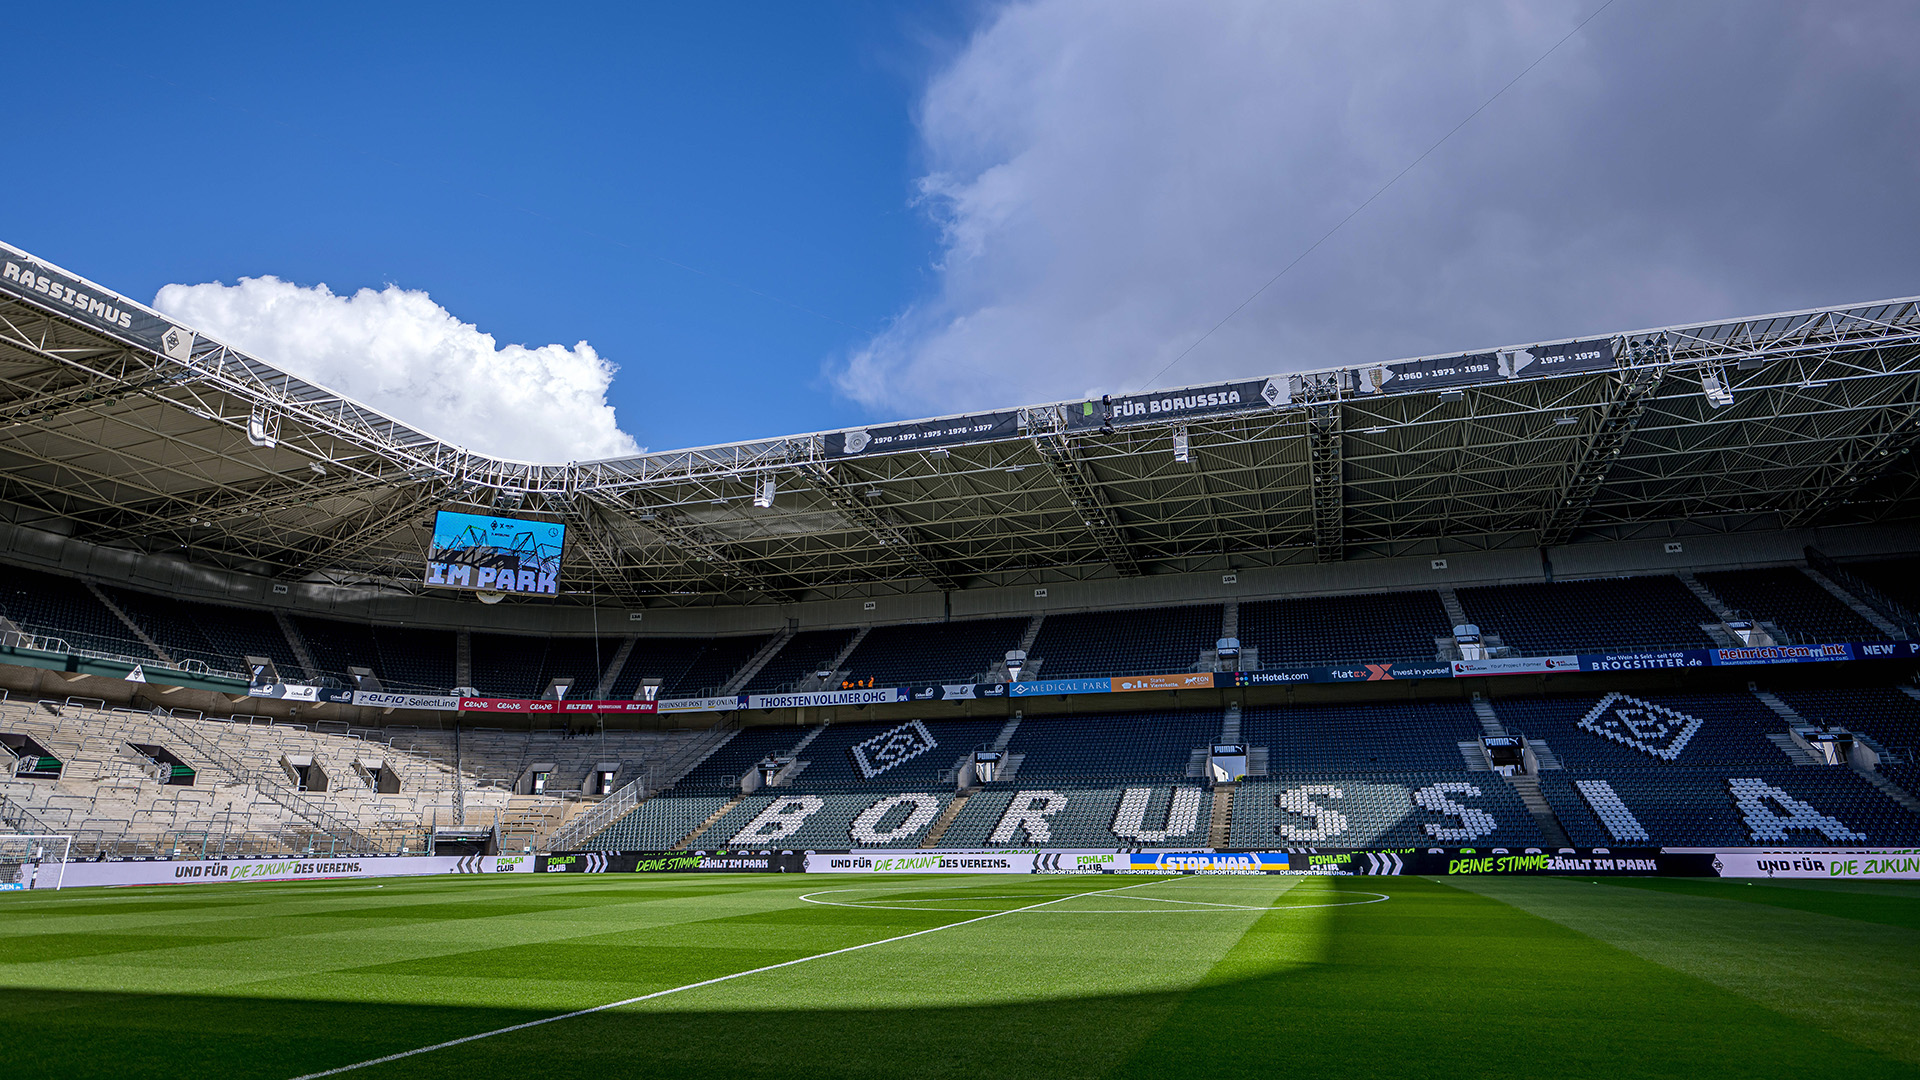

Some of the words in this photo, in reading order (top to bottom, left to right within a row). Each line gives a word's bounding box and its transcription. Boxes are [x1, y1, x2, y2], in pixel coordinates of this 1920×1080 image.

[3, 261, 132, 328] RASSISMUS
[1540, 355, 1564, 364] 1975
[1575, 351, 1600, 360] 1979
[1398, 372, 1422, 381] 1960
[1432, 368, 1455, 377] 1973
[1464, 364, 1490, 373] 1995
[1113, 401, 1146, 418] FÜR
[1150, 390, 1240, 413] BORUSSIA
[874, 436, 892, 444] 1970
[899, 433, 916, 442] 1971
[924, 430, 942, 438] 1975
[948, 427, 967, 435] 1976
[974, 424, 992, 432] 1977
[428, 562, 471, 586] IM
[476, 566, 558, 594] PARK
[1720, 648, 1777, 660] Heinrich
[1778, 644, 1847, 658] Temmink
[1392, 668, 1411, 676] Invest
[1592, 658, 1702, 670] BROGSITTER.de
[1252, 672, 1308, 682] H-Hotels.com
[1030, 683, 1078, 692] MEDICAL
[1083, 681, 1109, 690] PARK
[408, 698, 456, 708] SelectLine
[760, 696, 812, 708] THORSTEN
[813, 694, 861, 706] VOLLMER
[863, 692, 886, 702] OHG
[728, 777, 1868, 846] BORUSSIA
[496, 856, 524, 865] FOHLEN
[548, 856, 576, 865] FOHLEN
[636, 858, 667, 872] DEINE
[667, 856, 702, 870] STIMME
[699, 856, 728, 868] ZÄHLT
[728, 860, 742, 868] IM
[743, 859, 768, 868] PARK
[830, 859, 851, 868] UND
[852, 856, 872, 868] FÜR
[874, 858, 893, 872] DIE
[894, 856, 942, 870] ZUKUNFT
[939, 859, 960, 868] DES
[960, 859, 1010, 868] VEREINS.
[1076, 854, 1114, 864] FOHLEN
[1166, 856, 1210, 870] STOP
[1213, 856, 1250, 870] WAR
[1308, 854, 1352, 865] FOHLEN
[1448, 857, 1494, 874] DEINE
[1496, 854, 1550, 872] STIMME
[1547, 856, 1592, 870] ZÄHLT
[1594, 859, 1615, 870] IM
[1616, 859, 1657, 870] PARK
[1756, 860, 1790, 872] UND
[1794, 857, 1826, 872] FÜR
[1830, 860, 1858, 876] DIE
[175, 866, 201, 878] UND
[204, 862, 228, 877] FÜR
[230, 864, 252, 880] DIE
[252, 860, 300, 877] ZUKUNFT
[294, 864, 314, 874] DES
[316, 862, 362, 874] VEREINS.
